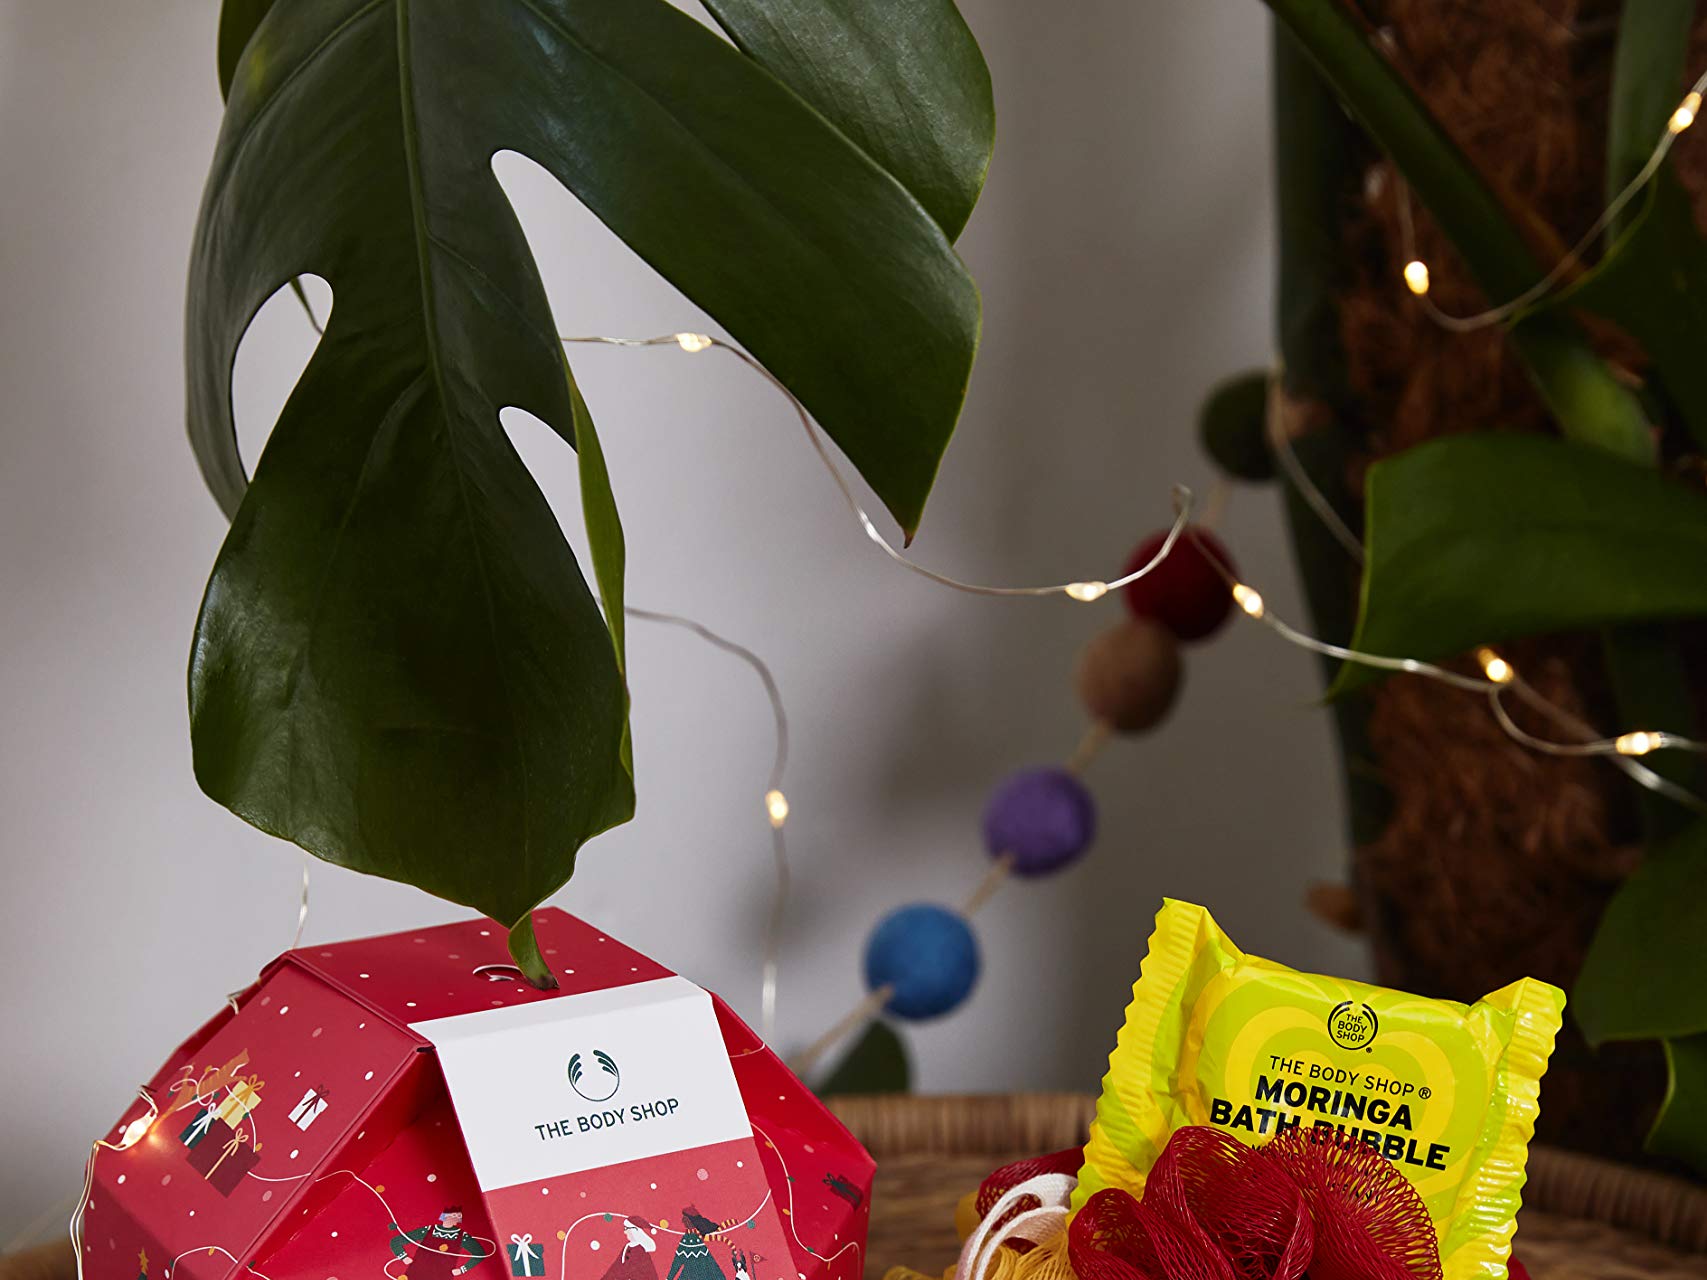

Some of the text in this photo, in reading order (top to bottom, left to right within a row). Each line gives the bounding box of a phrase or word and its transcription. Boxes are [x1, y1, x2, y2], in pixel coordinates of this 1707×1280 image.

[1338, 1020, 1367, 1034] BODY
[1347, 1014, 1363, 1024] THE
[1336, 1030, 1365, 1042] SHOP
[1270, 1055, 1304, 1076] THE
[1309, 1064, 1360, 1086] BODY
[1255, 1075, 1413, 1131] MORINGA
[535, 1098, 679, 1141] THE BODY SHOP
